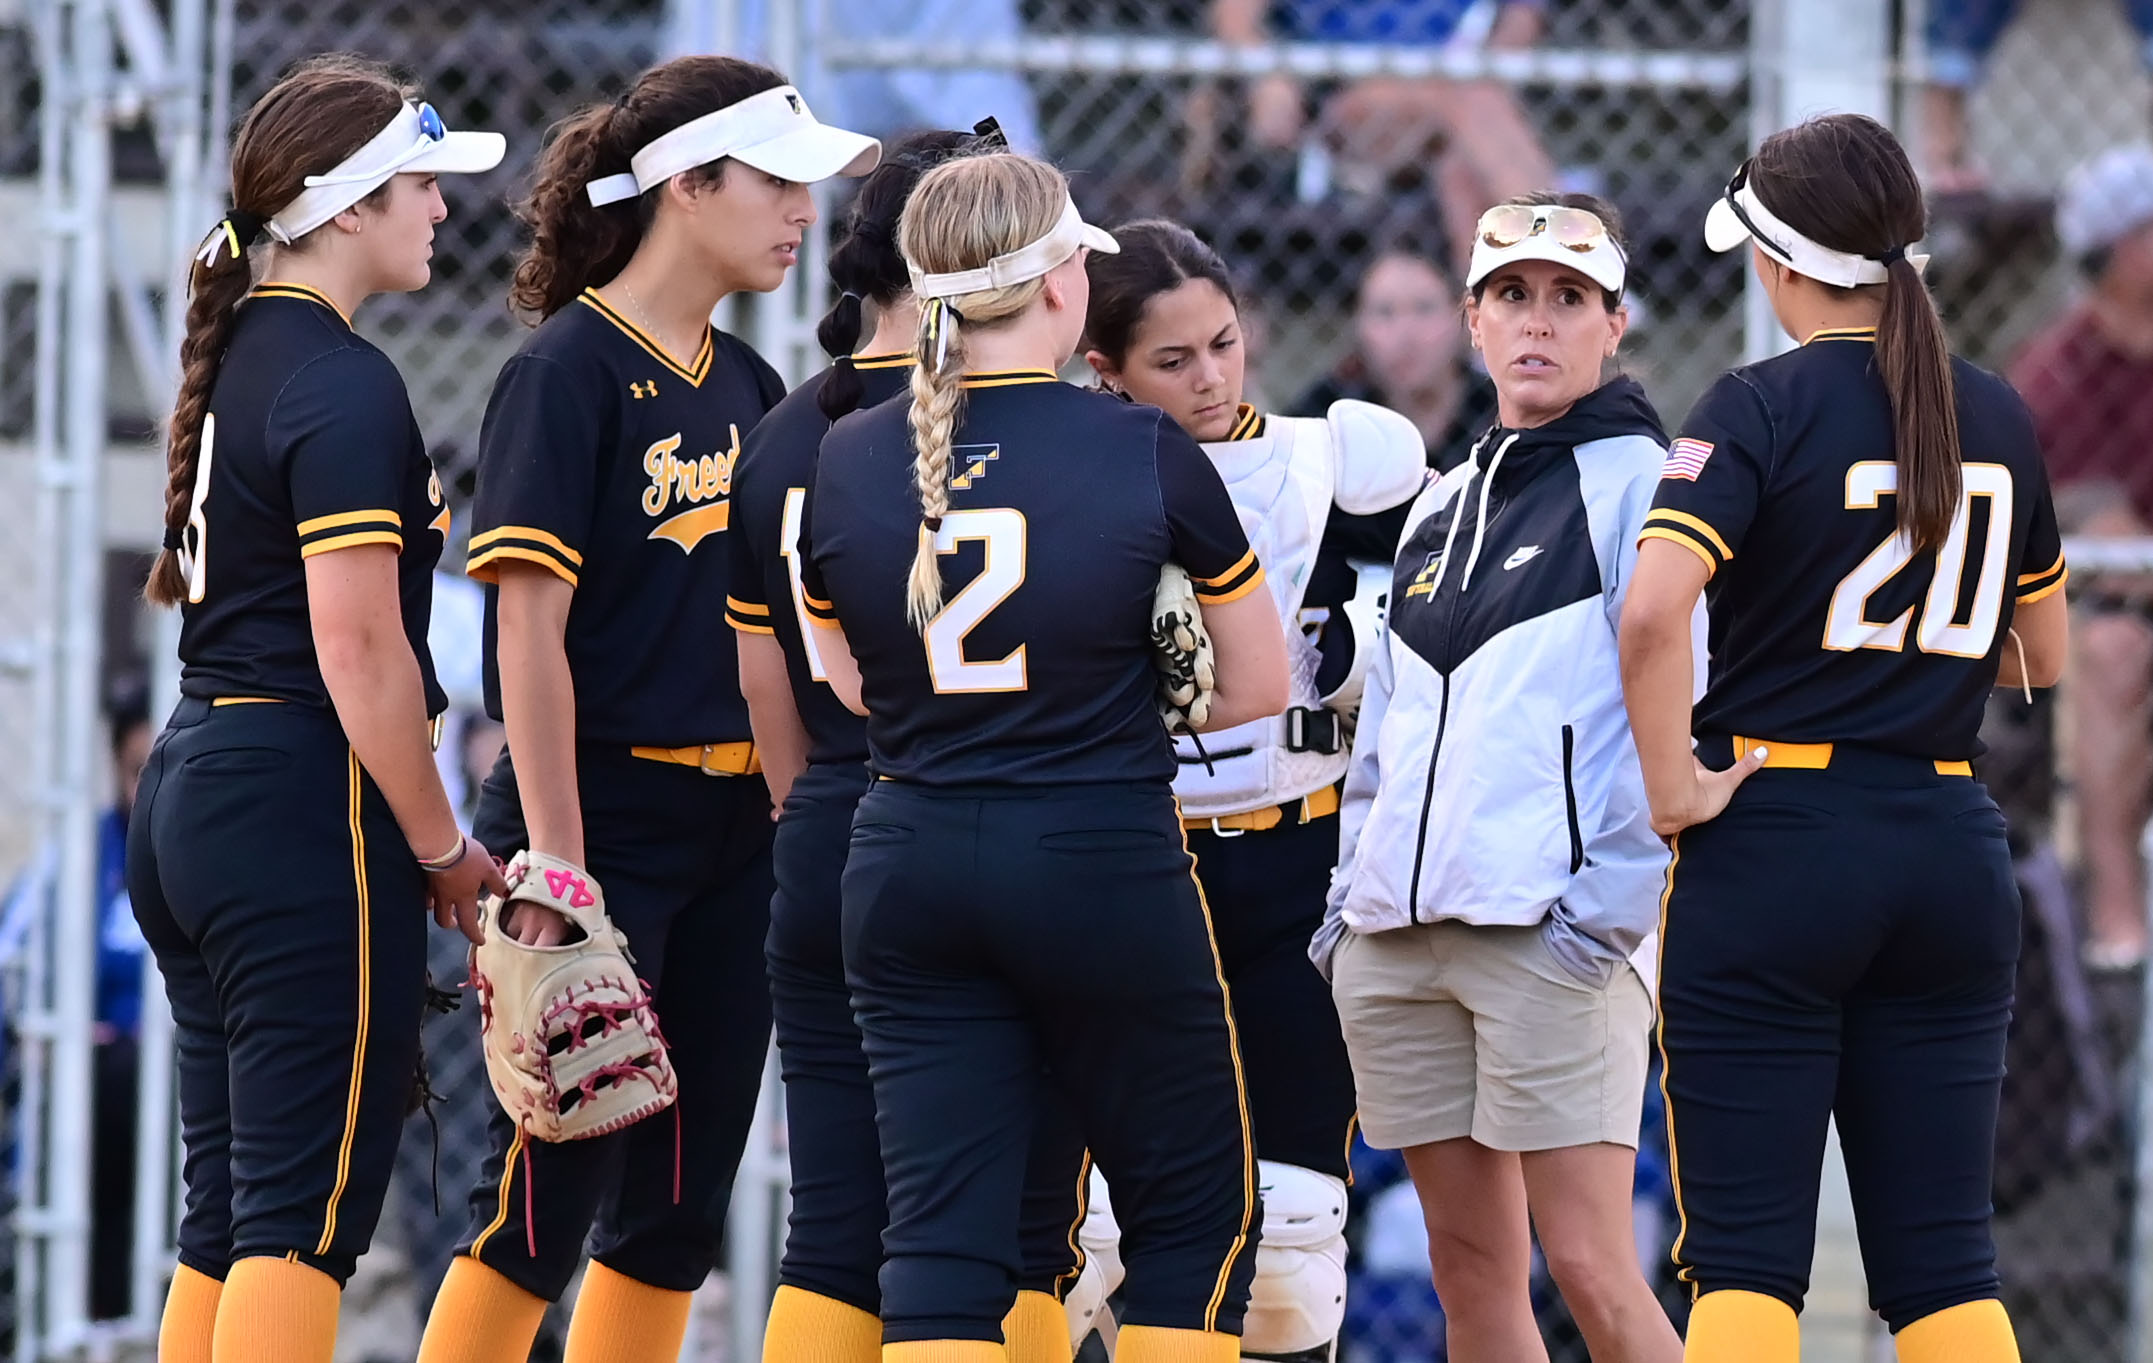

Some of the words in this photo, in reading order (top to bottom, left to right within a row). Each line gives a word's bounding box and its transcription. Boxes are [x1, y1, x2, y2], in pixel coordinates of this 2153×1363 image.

[918, 507, 1028, 694] 2
[1821, 459, 2014, 660] 20
[544, 868, 596, 908] 44
